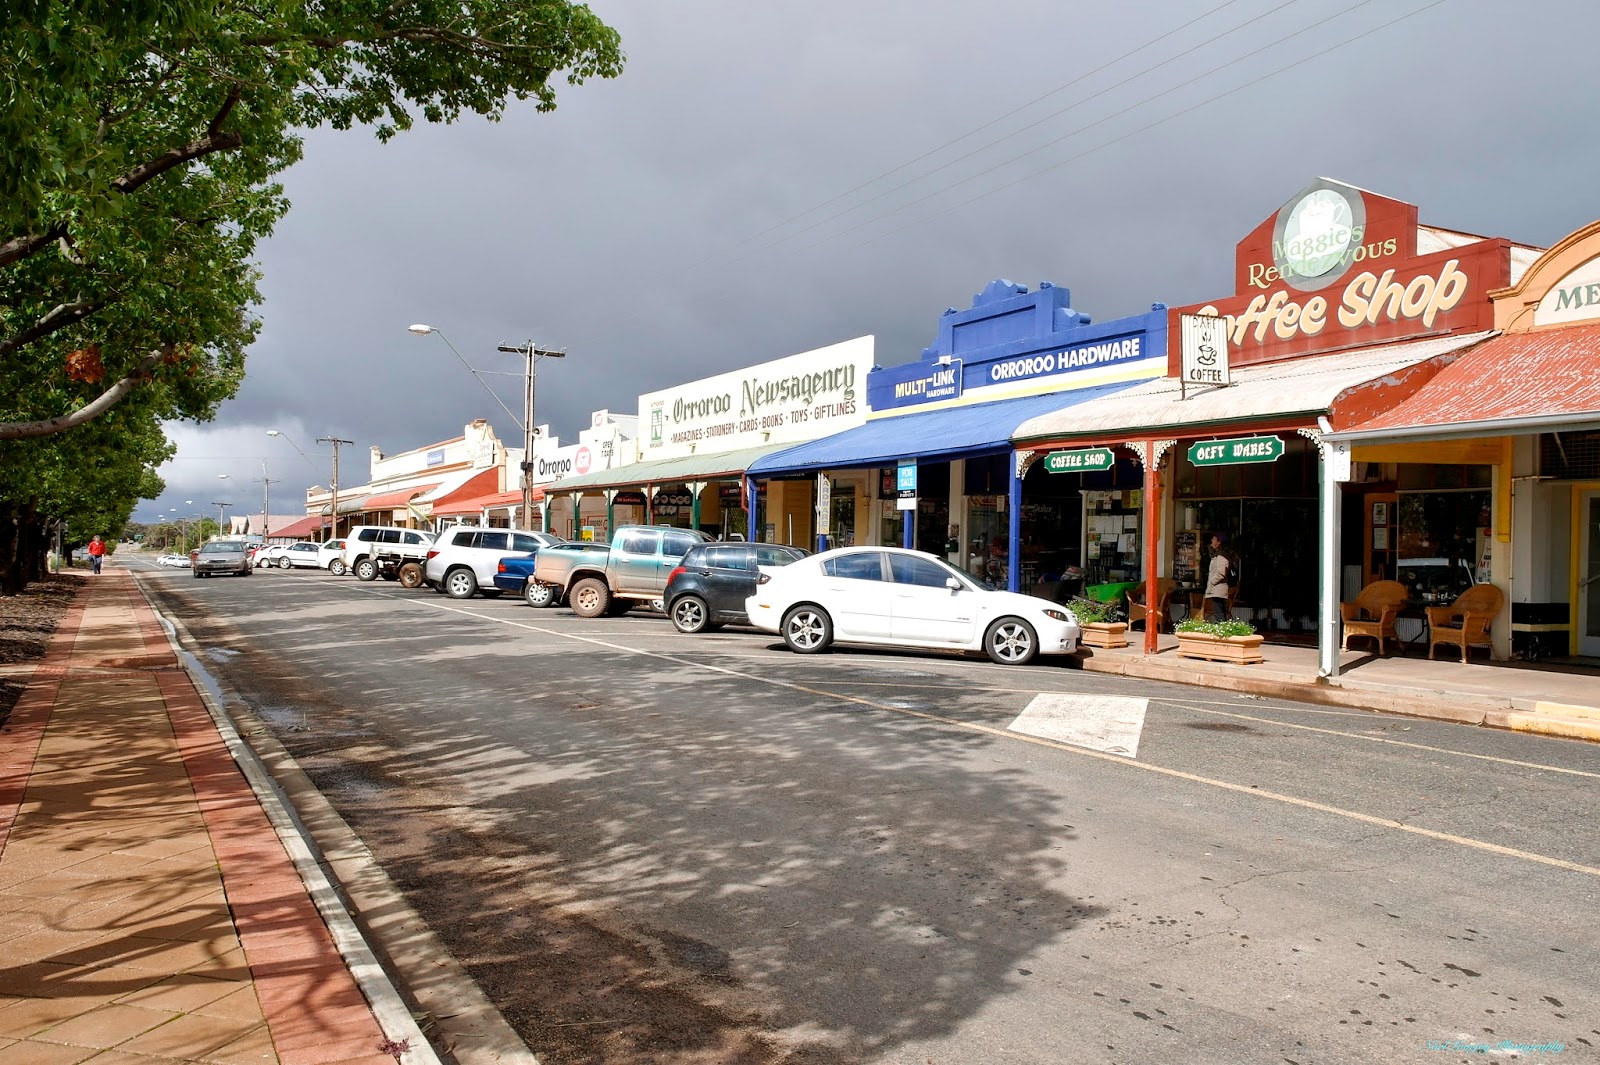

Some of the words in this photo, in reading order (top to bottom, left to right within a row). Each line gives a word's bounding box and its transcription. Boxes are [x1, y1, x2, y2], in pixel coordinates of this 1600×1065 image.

[1274, 225, 1363, 261] Maggie's
[1248, 238, 1397, 289] Rendezvous
[1197, 290, 1328, 347] ffee
[1338, 259, 1468, 329] Shop
[991, 354, 1055, 381] ORROROO
[1058, 338, 1140, 370] HARDWARE
[1190, 368, 1222, 382] COFFEE
[895, 370, 955, 399] MULTI-LINK
[926, 386, 955, 399] HARDWARE
[673, 393, 731, 425] Orroroo
[740, 363, 856, 418] Newsagency
[672, 428, 703, 443] MAGAZINES
[706, 423, 736, 439] STATIONERY
[739, 417, 758, 433] CARDS
[762, 413, 784, 429] BOOKS
[791, 408, 808, 425] TOYS
[814, 400, 856, 420] GIFTLINES
[602, 440, 614, 449] OPEN
[1233, 441, 1274, 458] WARES
[539, 458, 571, 476] Orroroo
[1050, 454, 1082, 469] COFFEE
[901, 468, 913, 477] FOR
[900, 477, 914, 487] SALE
